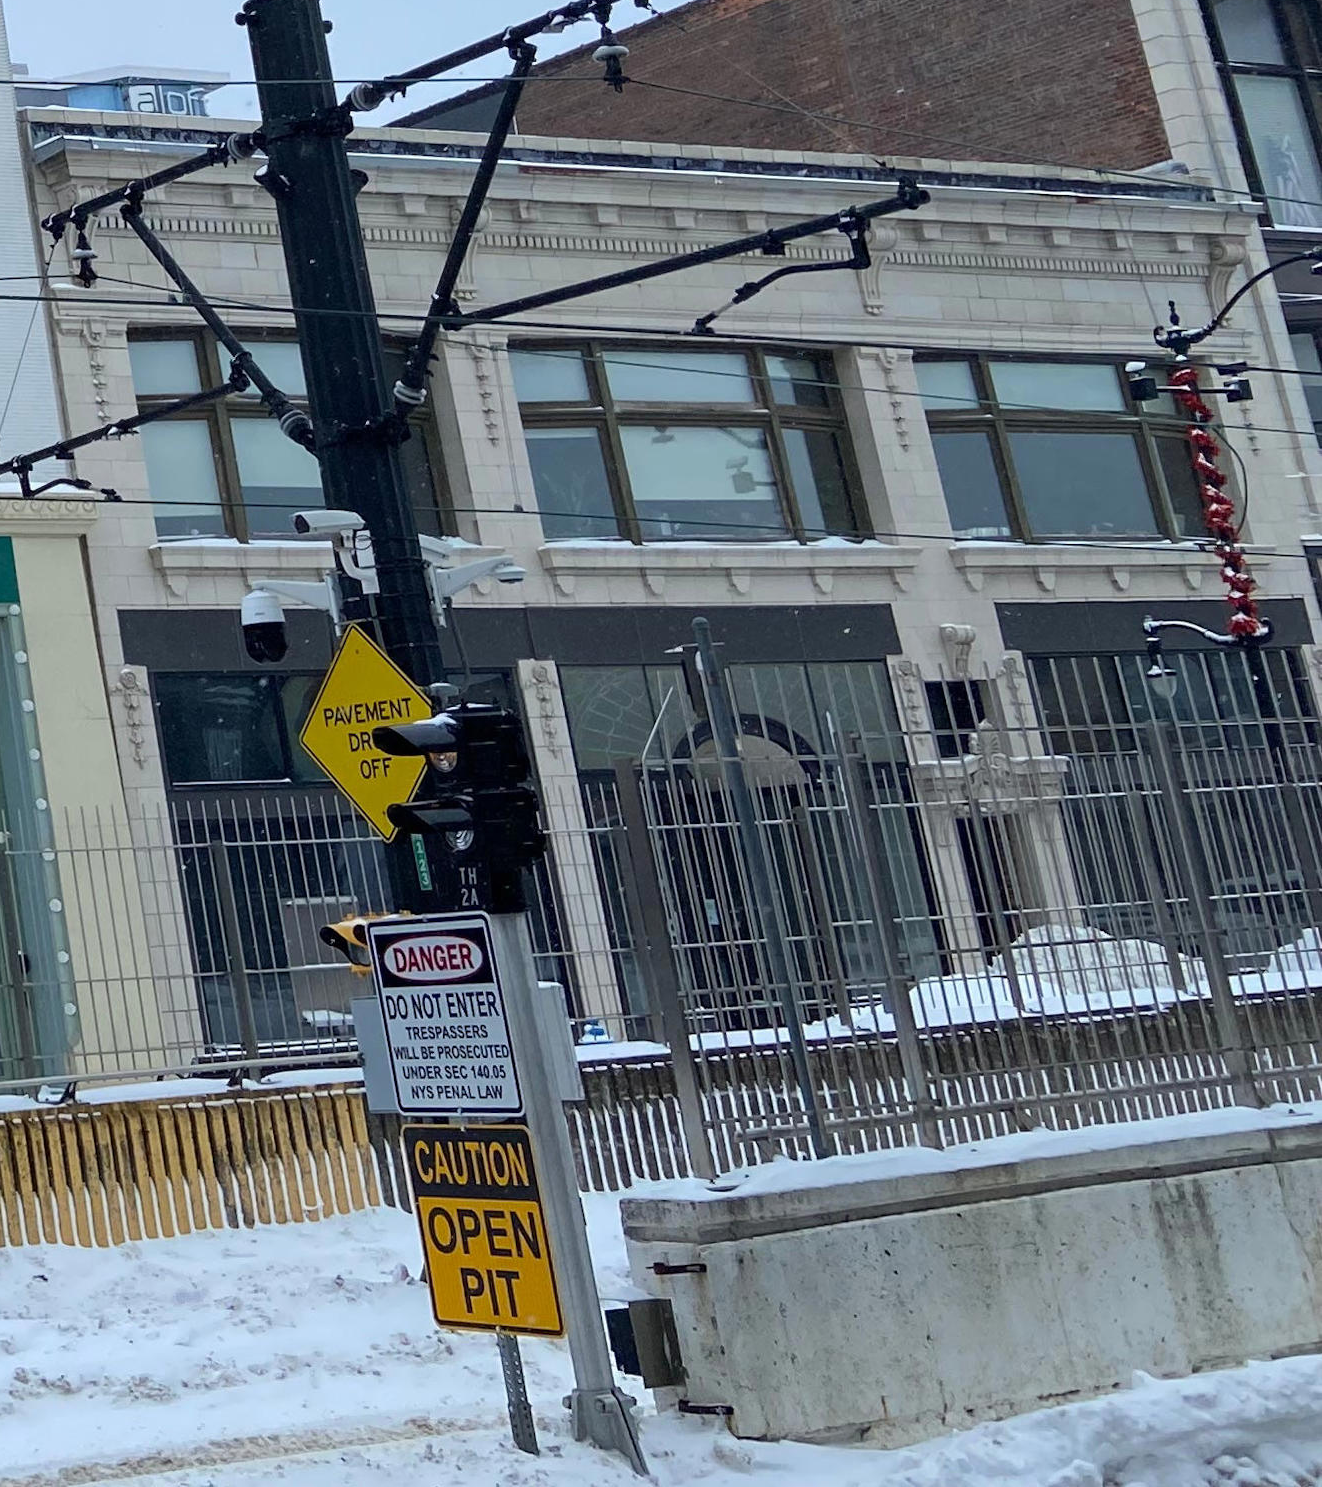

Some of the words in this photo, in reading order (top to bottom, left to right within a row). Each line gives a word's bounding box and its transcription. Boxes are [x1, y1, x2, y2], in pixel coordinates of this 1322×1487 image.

[323, 697, 412, 727] PAVEMENT
[360, 757, 392, 779] OFF
[459, 867, 478, 885] TH
[461, 888, 480, 906] 2A
[393, 943, 476, 973] DANGER
[385, 994, 407, 1020] DO
[411, 993, 442, 1019] NOT
[446, 991, 500, 1018] ENTER
[405, 1024, 489, 1040] TRESPASSERS
[393, 1045, 420, 1060] WILL
[422, 1045, 434, 1059] BE
[438, 1044, 510, 1060] PROSECUTED
[402, 1065, 442, 1079] UNDER
[445, 1065, 468, 1079] SEC
[470, 1064, 506, 1079] 140.05
[411, 1085, 434, 1100] NYS
[437, 1085, 476, 1099] PENAL
[477, 1085, 503, 1099] LAW
[414, 1140, 530, 1187] CAUTION
[428, 1206, 542, 1259] OPEN
[460, 1267, 520, 1318] PIT
